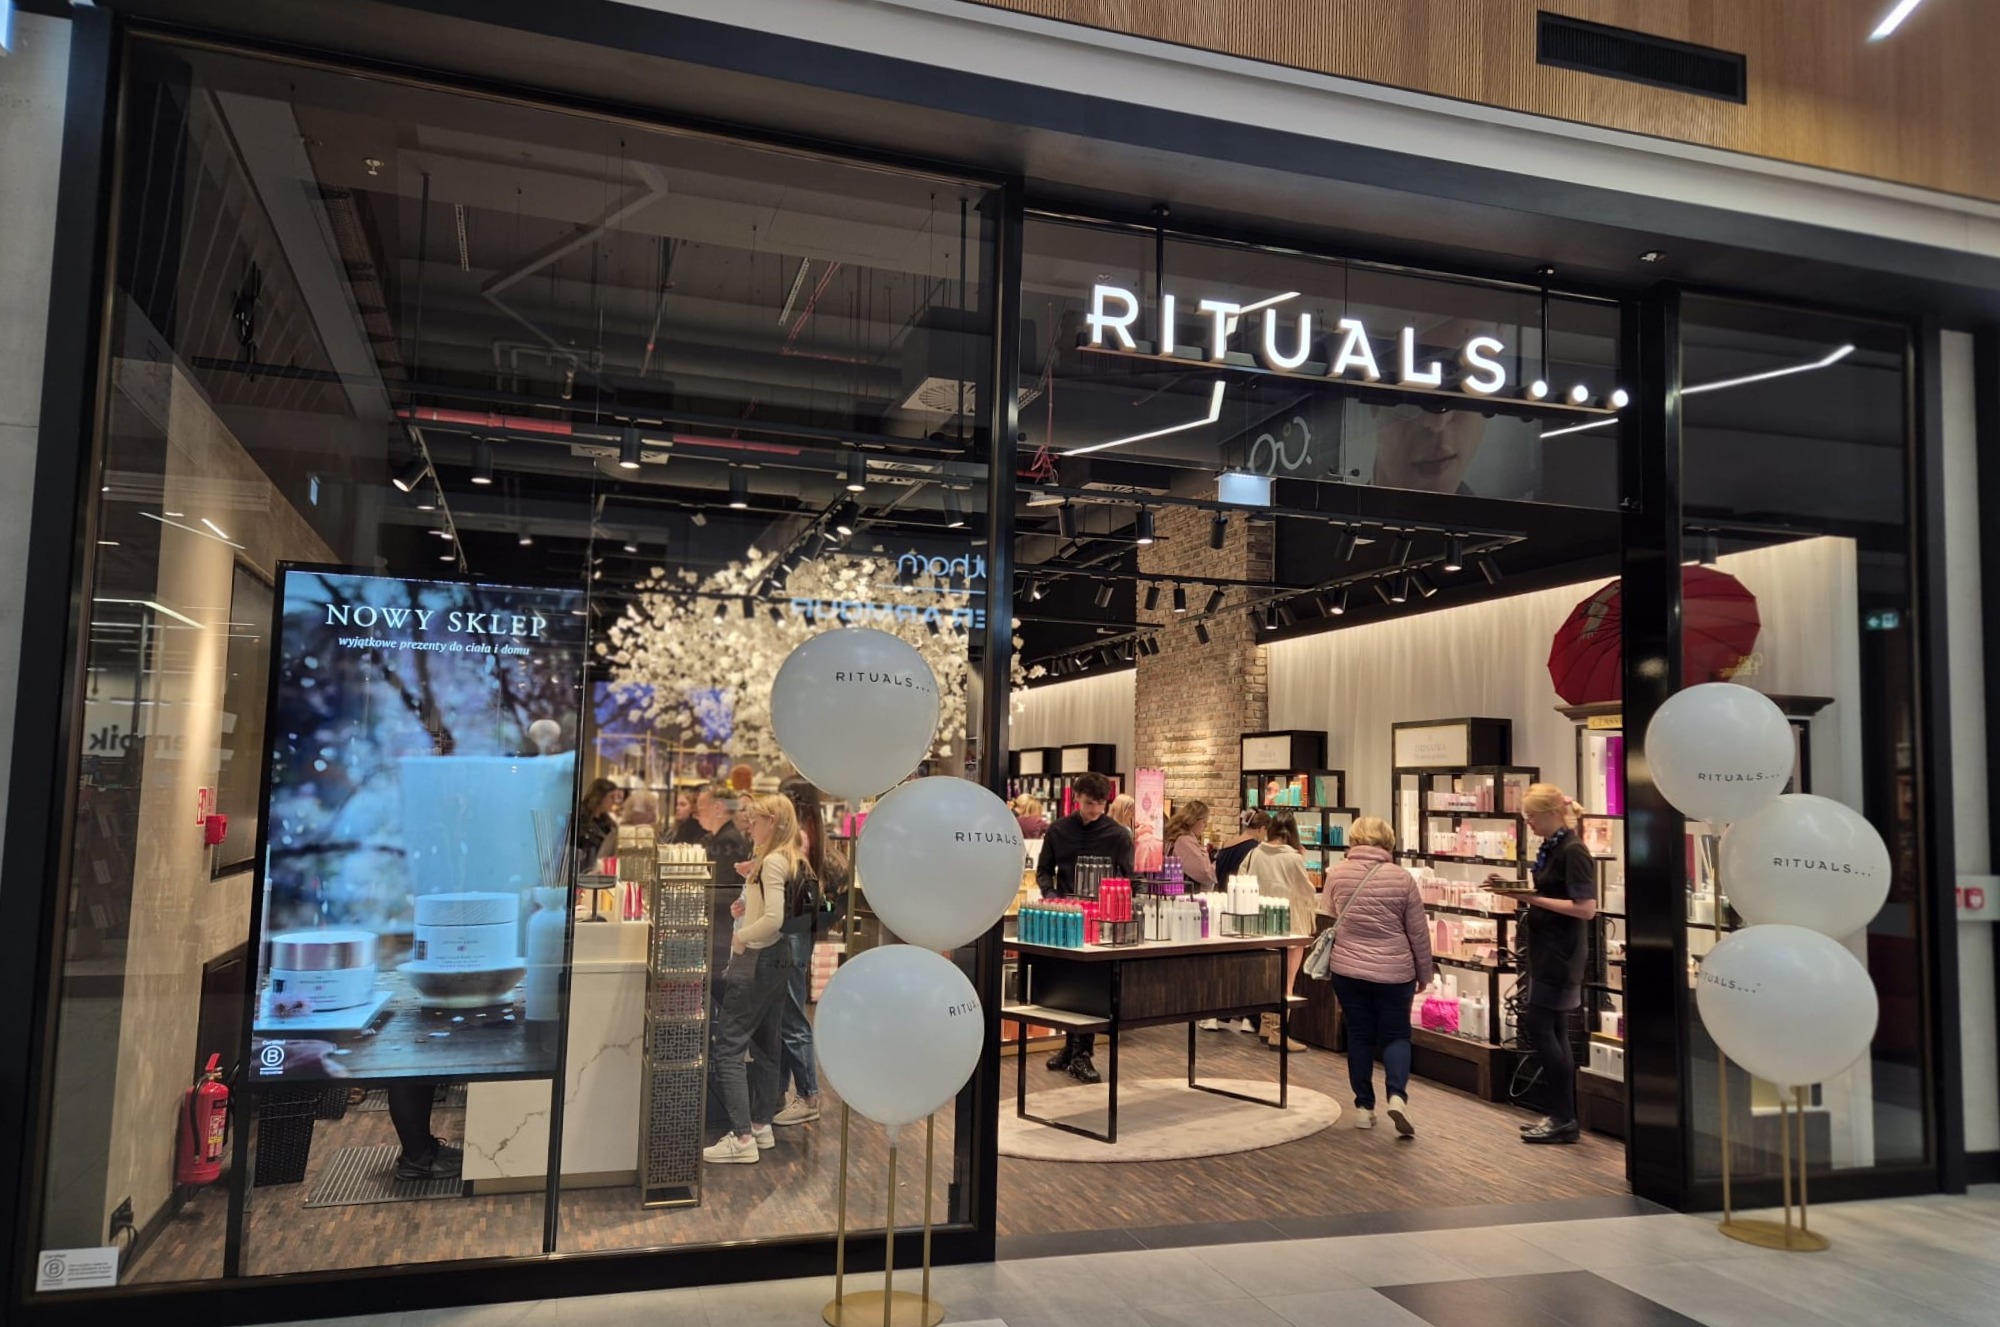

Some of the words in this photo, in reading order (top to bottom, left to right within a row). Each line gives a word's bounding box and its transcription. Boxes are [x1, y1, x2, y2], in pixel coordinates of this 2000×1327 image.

[1086, 283, 1628, 408] RITUALS...
[325, 603, 434, 630] NOWY
[447, 611, 548, 637] SKLEP
[338, 636, 397, 648] wyjątkowe
[399, 640, 447, 652] prezenty
[449, 641, 463, 652] do
[465, 643, 491, 654] ciała
[494, 643, 499, 654] i
[500, 645, 530, 656] domu
[266, 1049, 279, 1063] B
